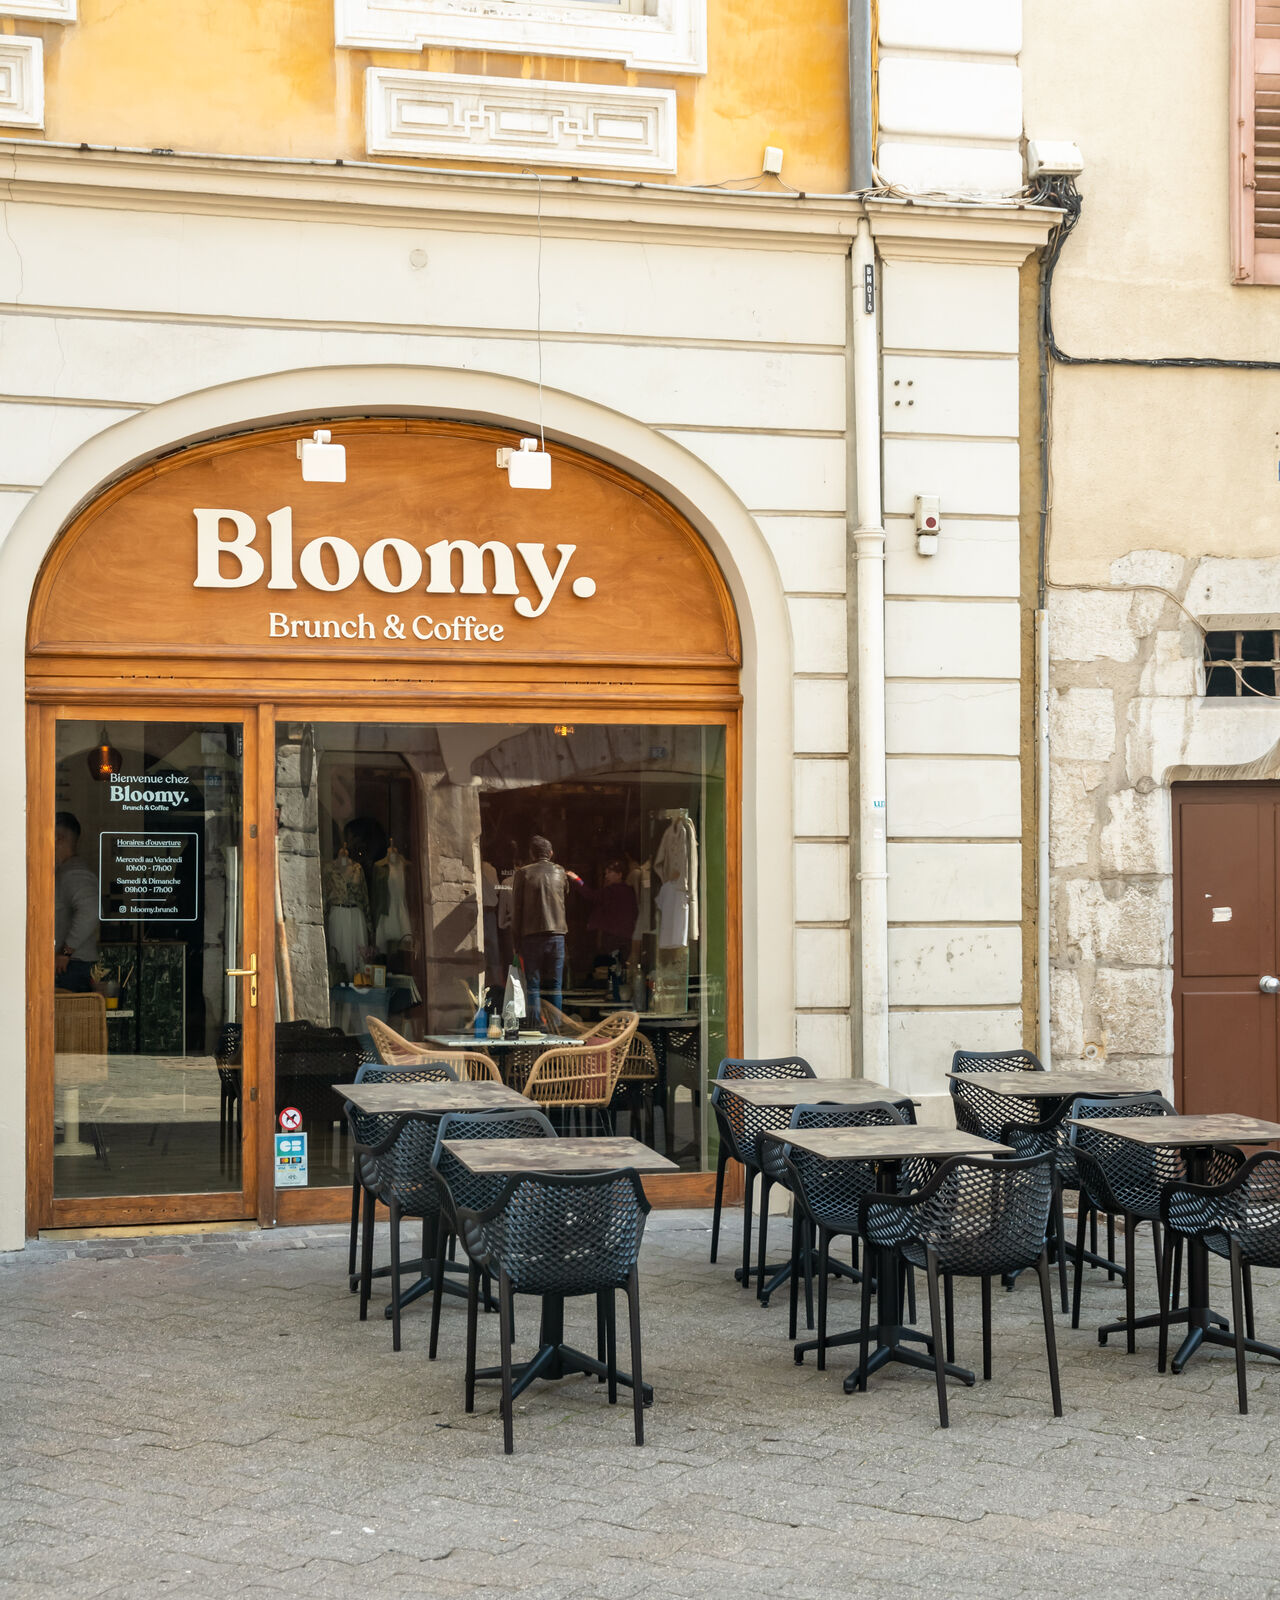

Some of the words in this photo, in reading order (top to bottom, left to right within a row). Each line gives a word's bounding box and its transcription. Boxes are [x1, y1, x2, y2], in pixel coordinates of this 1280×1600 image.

[192, 505, 597, 618] Bloomy.
[268, 612, 377, 639] Brunch
[383, 614, 407, 639] &
[412, 615, 505, 642] Coffee
[110, 773, 164, 783] Bienvenue
[165, 773, 190, 784] chez
[110, 785, 190, 806] Bloomy.
[116, 839, 145, 848] Horaires
[145, 839, 182, 848] d'ouverture
[115, 856, 145, 864] Mercredi
[154, 856, 183, 864] Vendredi
[125, 864, 147, 872] 10h00
[152, 864, 173, 872] 17h00
[116, 877, 141, 885] Samedi
[148, 877, 181, 885] Dimanche
[124, 885, 148, 894] 09h00
[153, 886, 173, 894] 17h00
[130, 905, 179, 914] bloomy.brunch
[279, 1140, 302, 1153] CB
